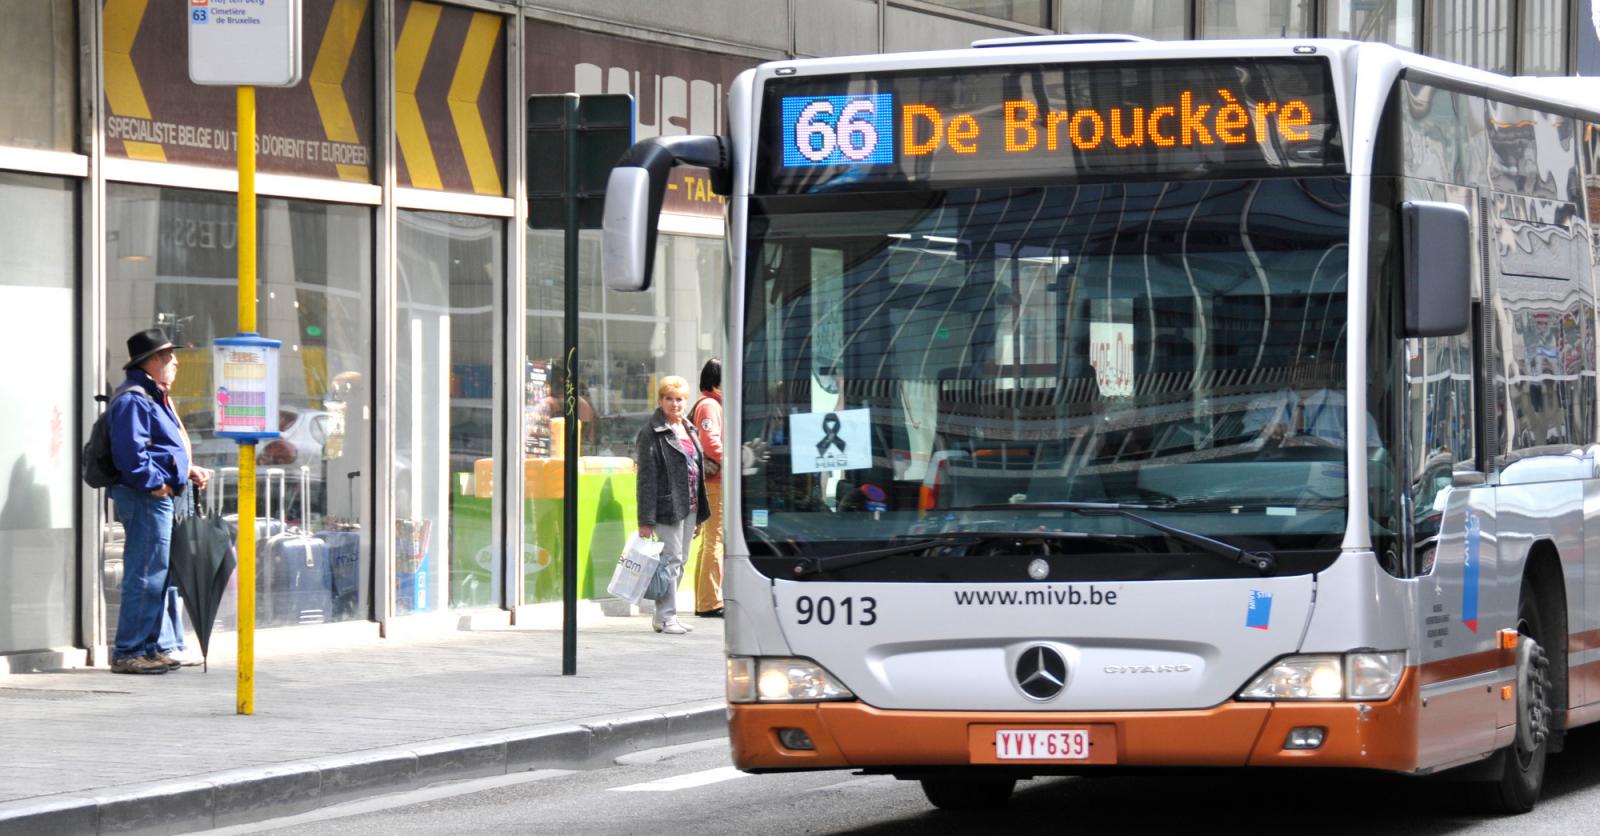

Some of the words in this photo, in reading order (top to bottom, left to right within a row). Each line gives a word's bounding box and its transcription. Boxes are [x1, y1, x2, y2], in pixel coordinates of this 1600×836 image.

[192, 10, 207, 21] 63
[108, 116, 176, 145] SPECIALISTE
[178, 125, 212, 148] BELGE
[214, 129, 229, 151] DU
[796, 100, 878, 162] 66
[903, 104, 980, 155] De
[1004, 88, 1312, 153] Brouckère
[262, 134, 305, 159] D'ORIENT
[307, 140, 320, 160] ET
[954, 585, 1117, 605] www.mivb.be
[796, 595, 877, 626] 9013
